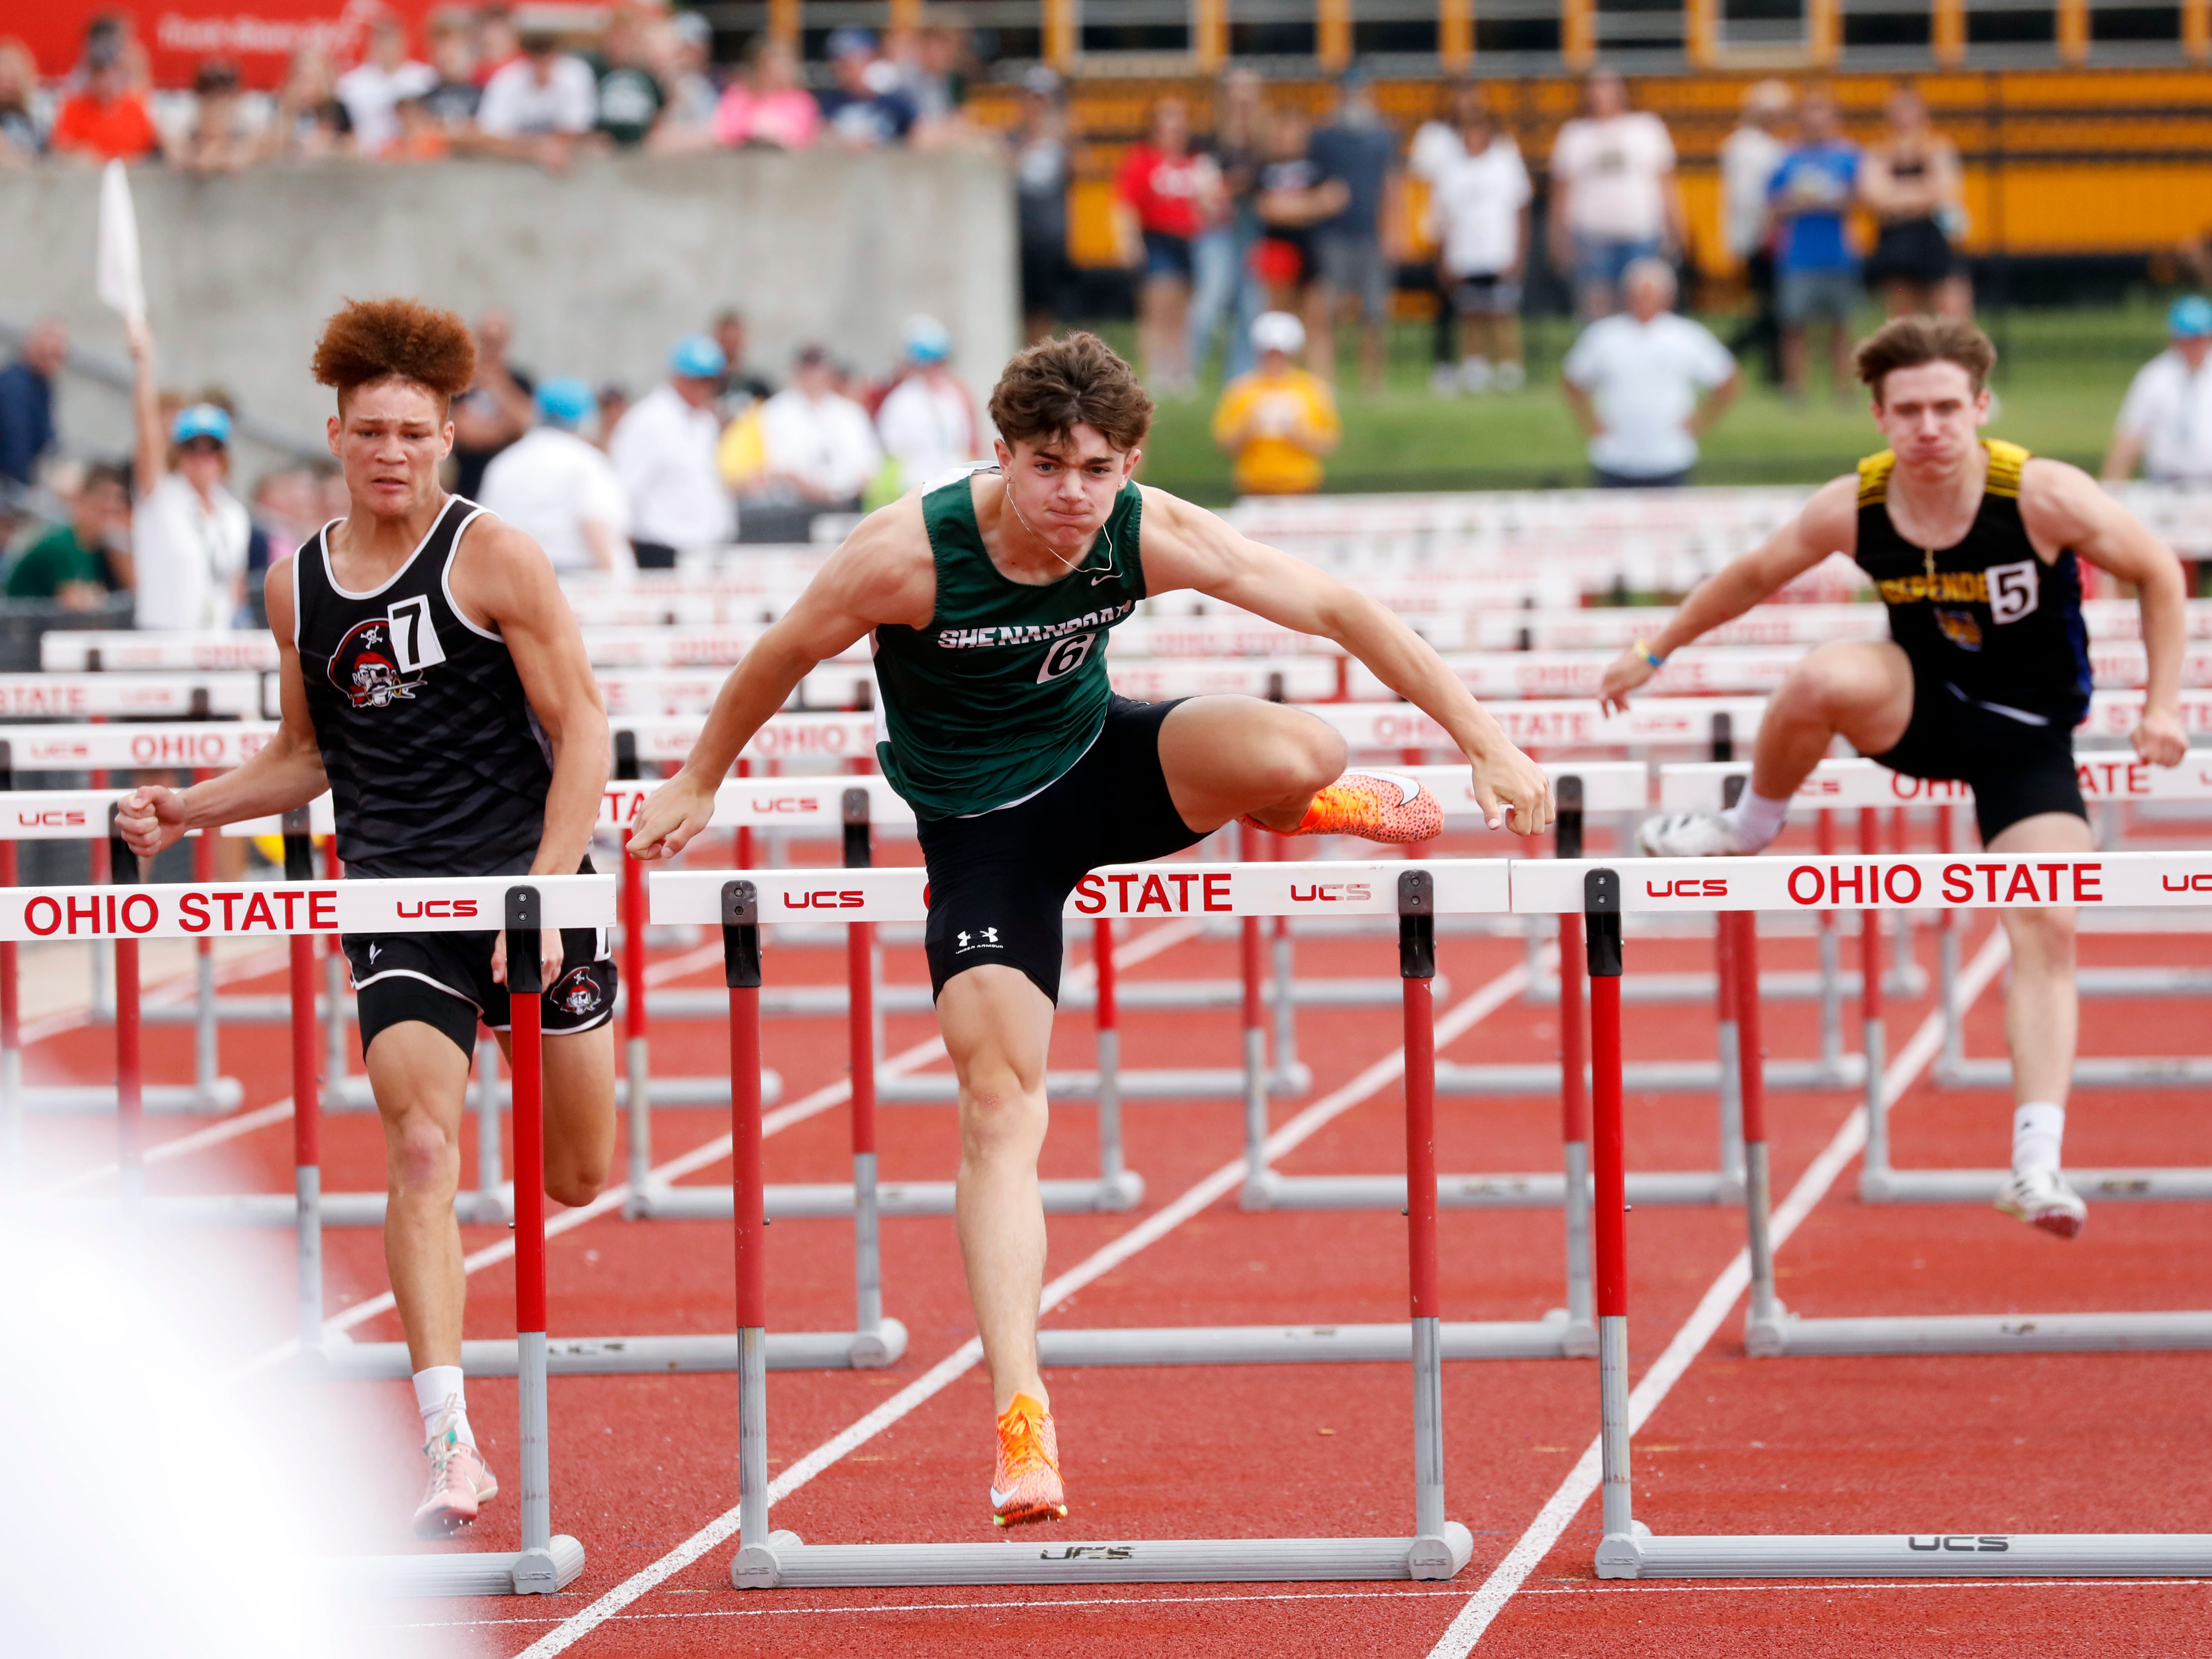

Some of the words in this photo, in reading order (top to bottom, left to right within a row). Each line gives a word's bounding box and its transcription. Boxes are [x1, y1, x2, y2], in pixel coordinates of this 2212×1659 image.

[1999, 570, 2029, 614] 5
[392, 603, 421, 666] 7
[1047, 634, 1084, 676] 6
[131, 733, 226, 765] OHIO
[2077, 763, 2152, 794] ATE
[753, 798, 818, 813] UCS
[19, 811, 86, 826] UCS
[1647, 879, 1728, 897] UCS
[1788, 864, 1922, 905] OHIO
[1942, 863, 2103, 904] STATE
[2162, 874, 2212, 892] UC
[784, 890, 864, 909] UCS
[1075, 873, 1233, 914] STATE
[1290, 884, 1371, 902] UCS
[24, 893, 159, 936] OHIO
[179, 890, 339, 932] STATE
[397, 900, 478, 918] UCS
[956, 945, 975, 954] UNDER
[1909, 1536, 2008, 1552] UCS
